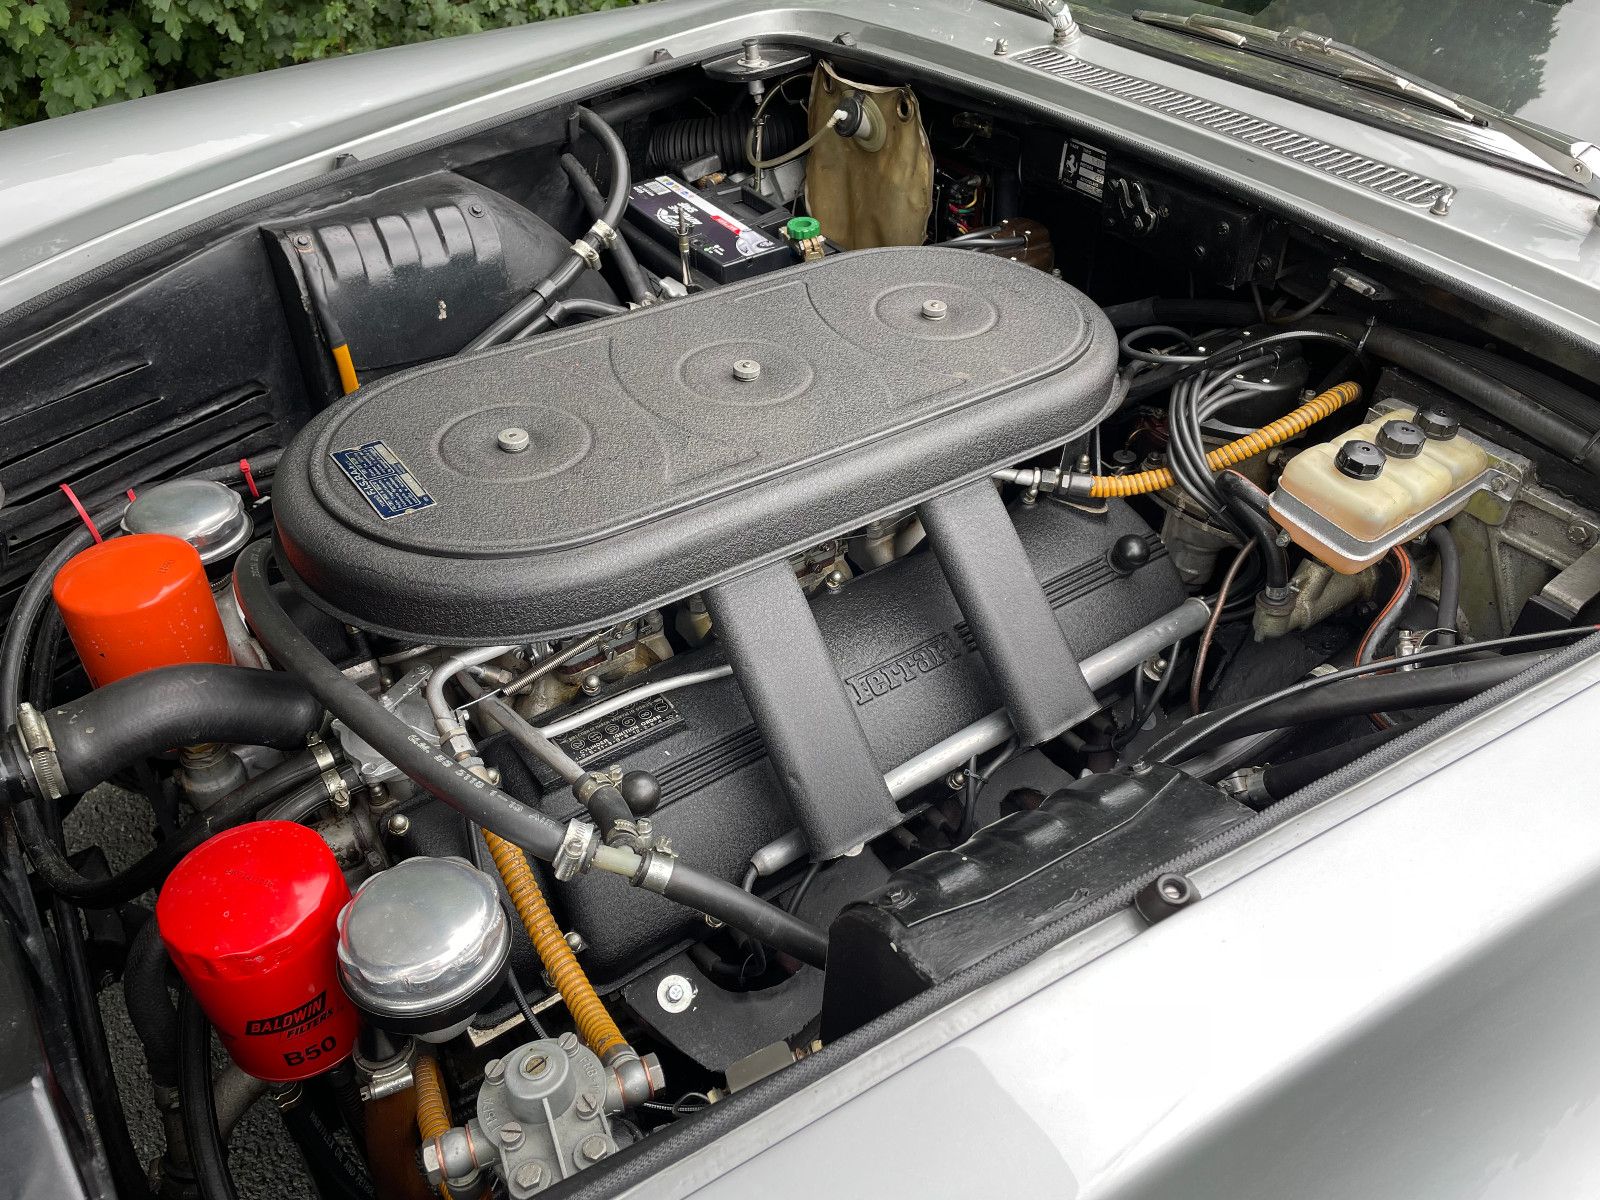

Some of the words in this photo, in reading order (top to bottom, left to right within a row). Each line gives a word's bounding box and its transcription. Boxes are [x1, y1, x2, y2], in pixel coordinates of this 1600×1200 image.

[844, 632, 961, 706] Ferrari
[250, 996, 324, 1033] BALDWIN
[287, 1008, 334, 1040] FILTERS
[282, 1036, 336, 1067] B50
